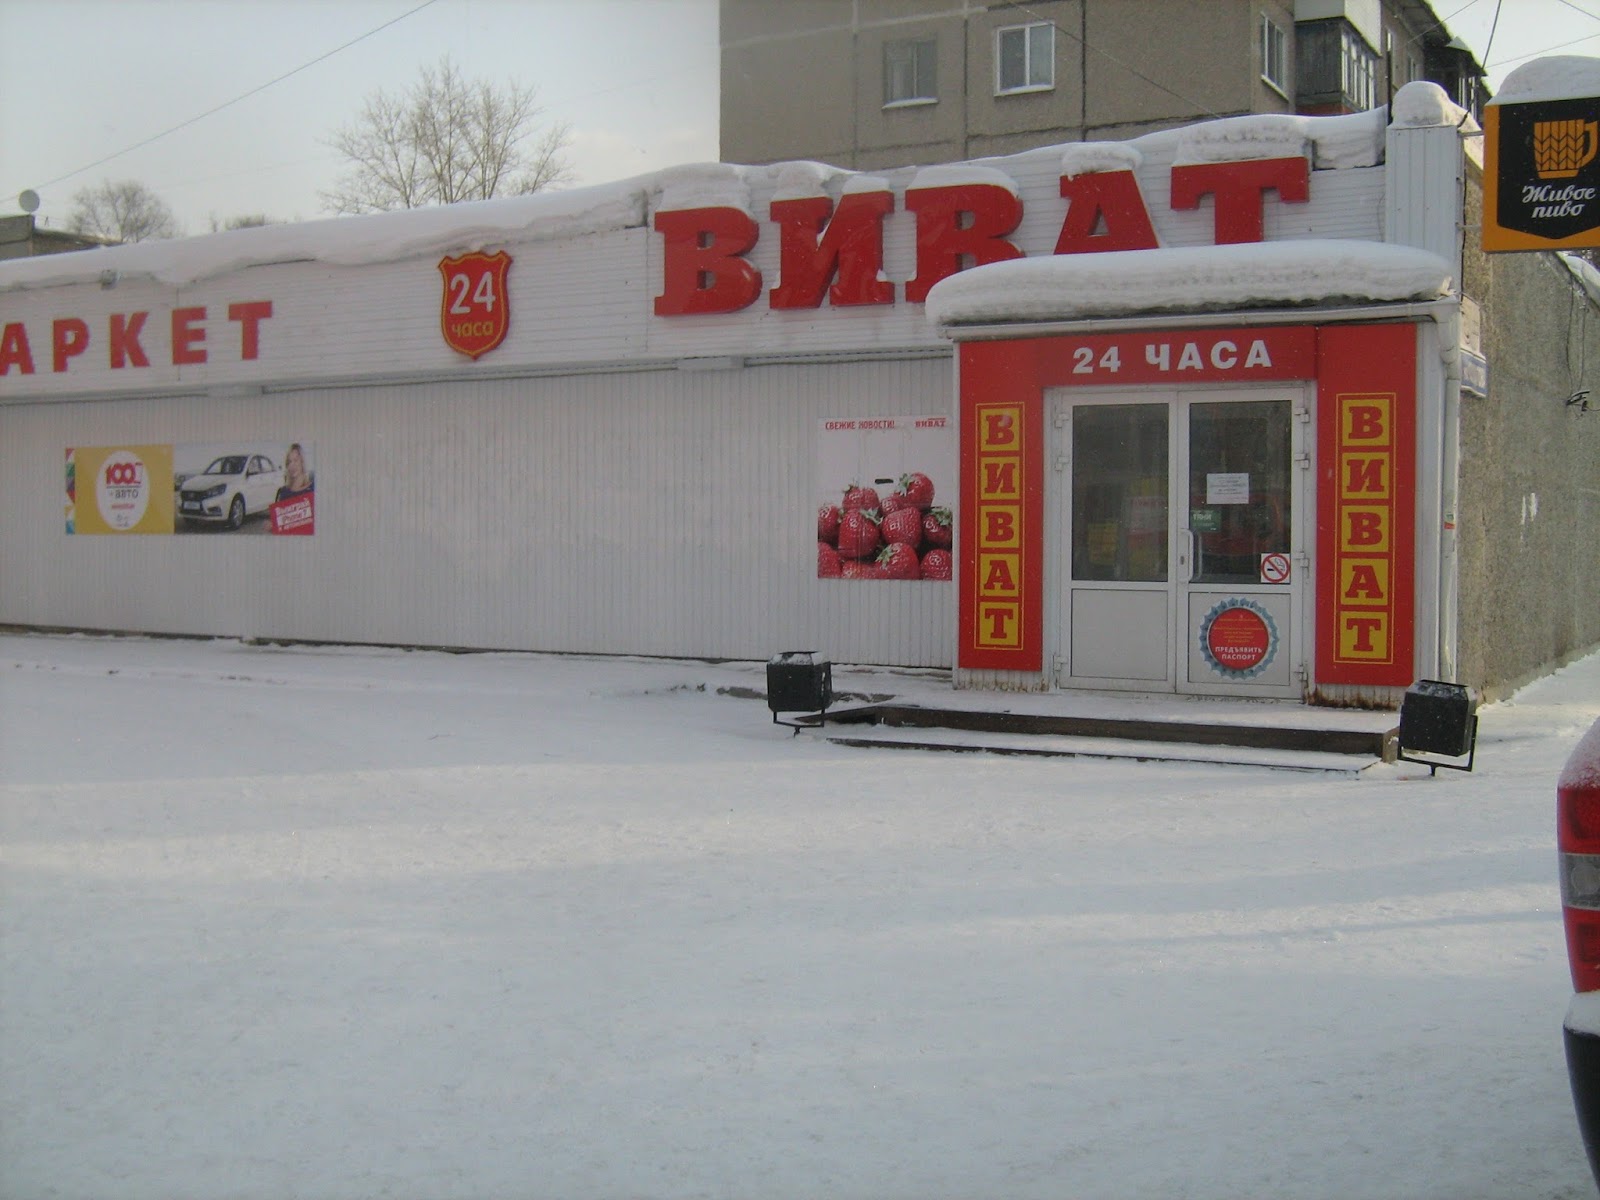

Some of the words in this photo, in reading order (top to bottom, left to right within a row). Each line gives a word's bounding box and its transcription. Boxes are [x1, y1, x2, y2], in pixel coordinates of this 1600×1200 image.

[1521, 184, 1596, 204] Живое
[1531, 200, 1585, 218] пиво
[654, 157, 1310, 316] ВИВАТ
[449, 271, 497, 315] 24
[0, 300, 273, 377] АРКЕТ
[452, 320, 495, 338] часа
[1072, 346, 1122, 374] 24
[1145, 339, 1273, 372] ЧАСА
[825, 421, 856, 431] СВЕЖИЕ
[858, 420, 895, 430] НОВОСТИ!
[915, 419, 946, 428] ВИВАТ
[984, 413, 1016, 640] ВИВАТ
[1345, 405, 1386, 652] ВИВАТ
[1215, 646, 1262, 654] ПРЕДЪЯВИТЬ
[1221, 653, 1256, 661] ПАСПОРТ
